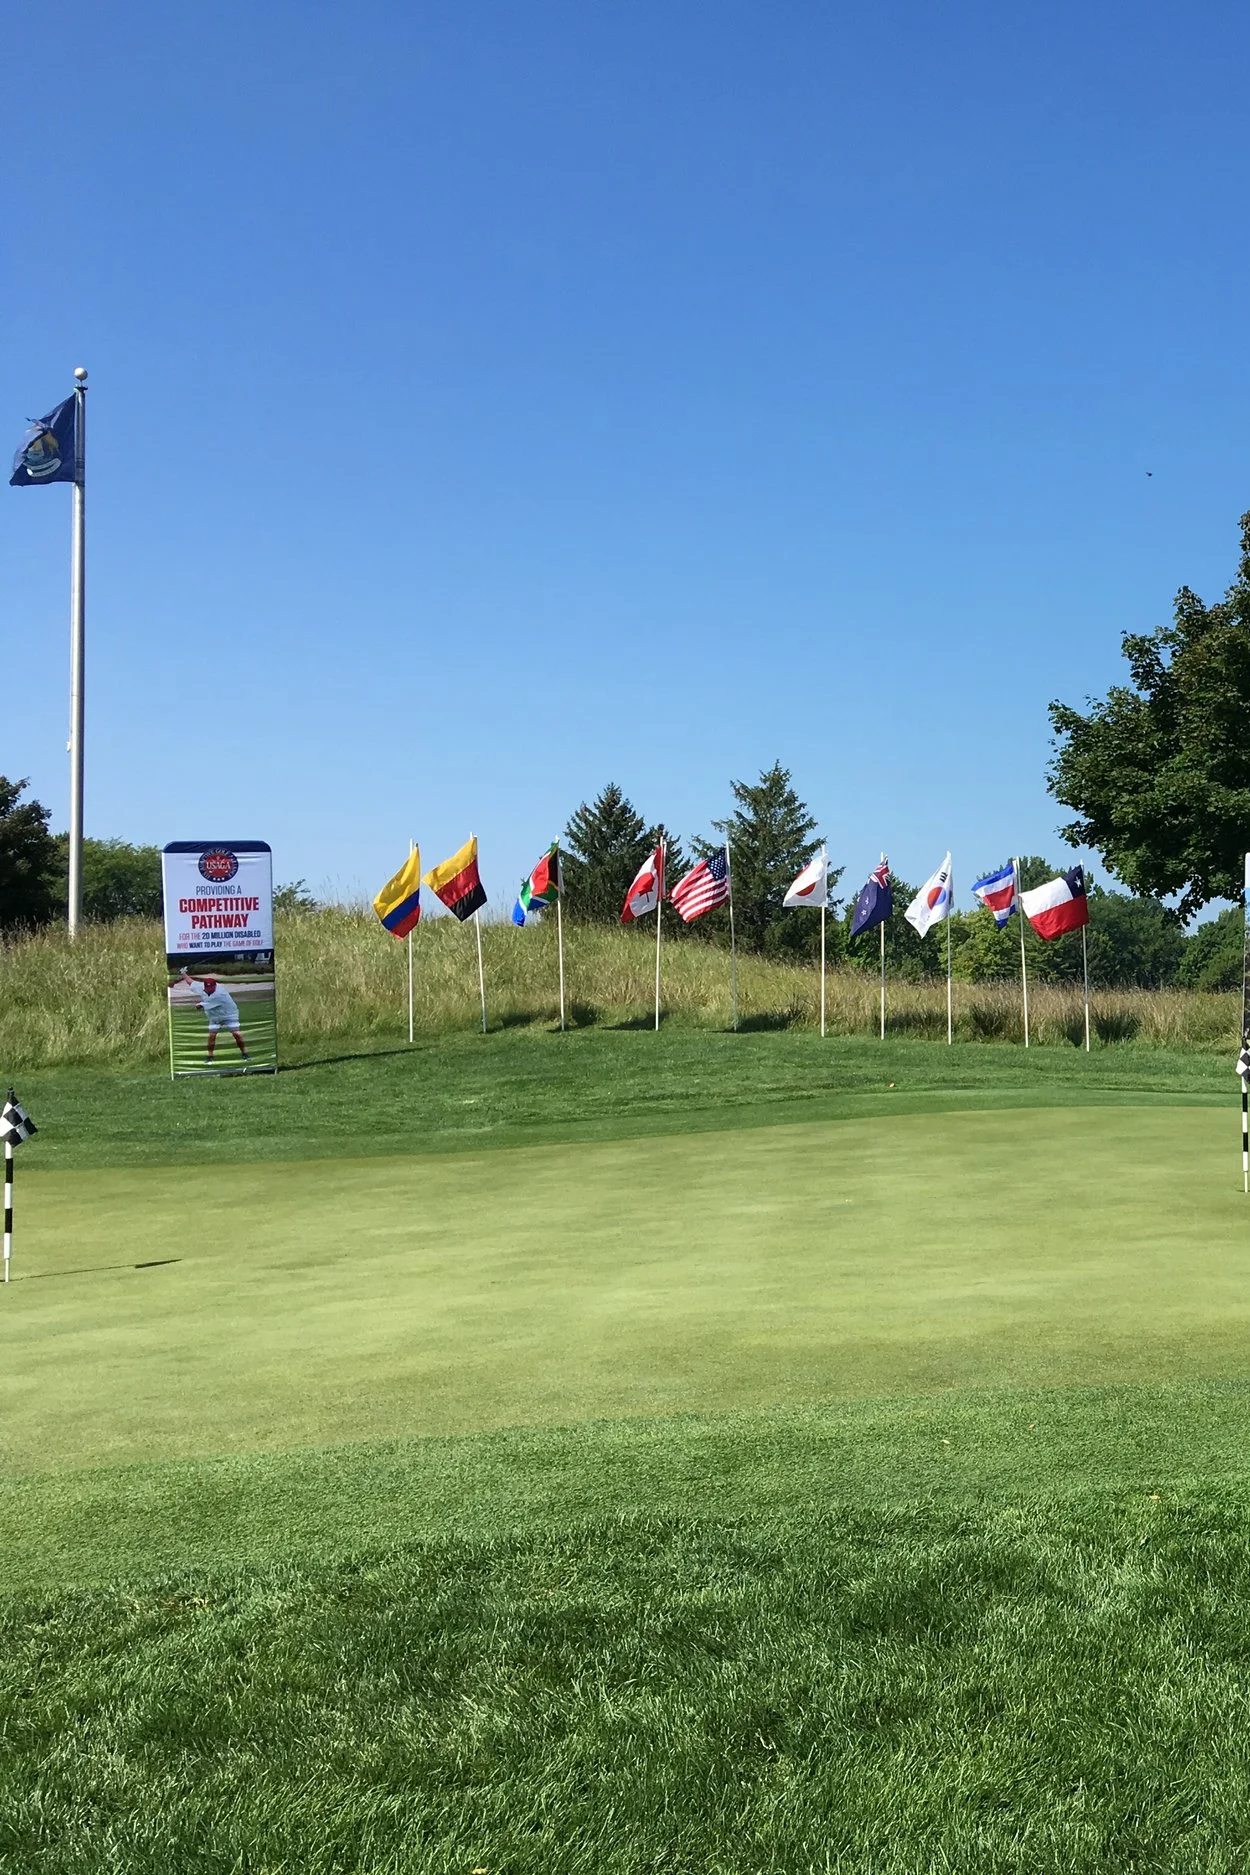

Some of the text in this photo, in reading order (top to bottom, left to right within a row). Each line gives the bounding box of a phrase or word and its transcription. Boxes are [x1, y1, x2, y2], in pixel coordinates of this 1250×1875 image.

[206, 861, 231, 870] USAGA
[196, 885, 242, 895] PROVIDING A
[180, 897, 259, 913] COMPETITIVE
[191, 914, 249, 929] PATHWAY
[179, 930, 261, 941] FOR THE 20 MILLION DISABLED
